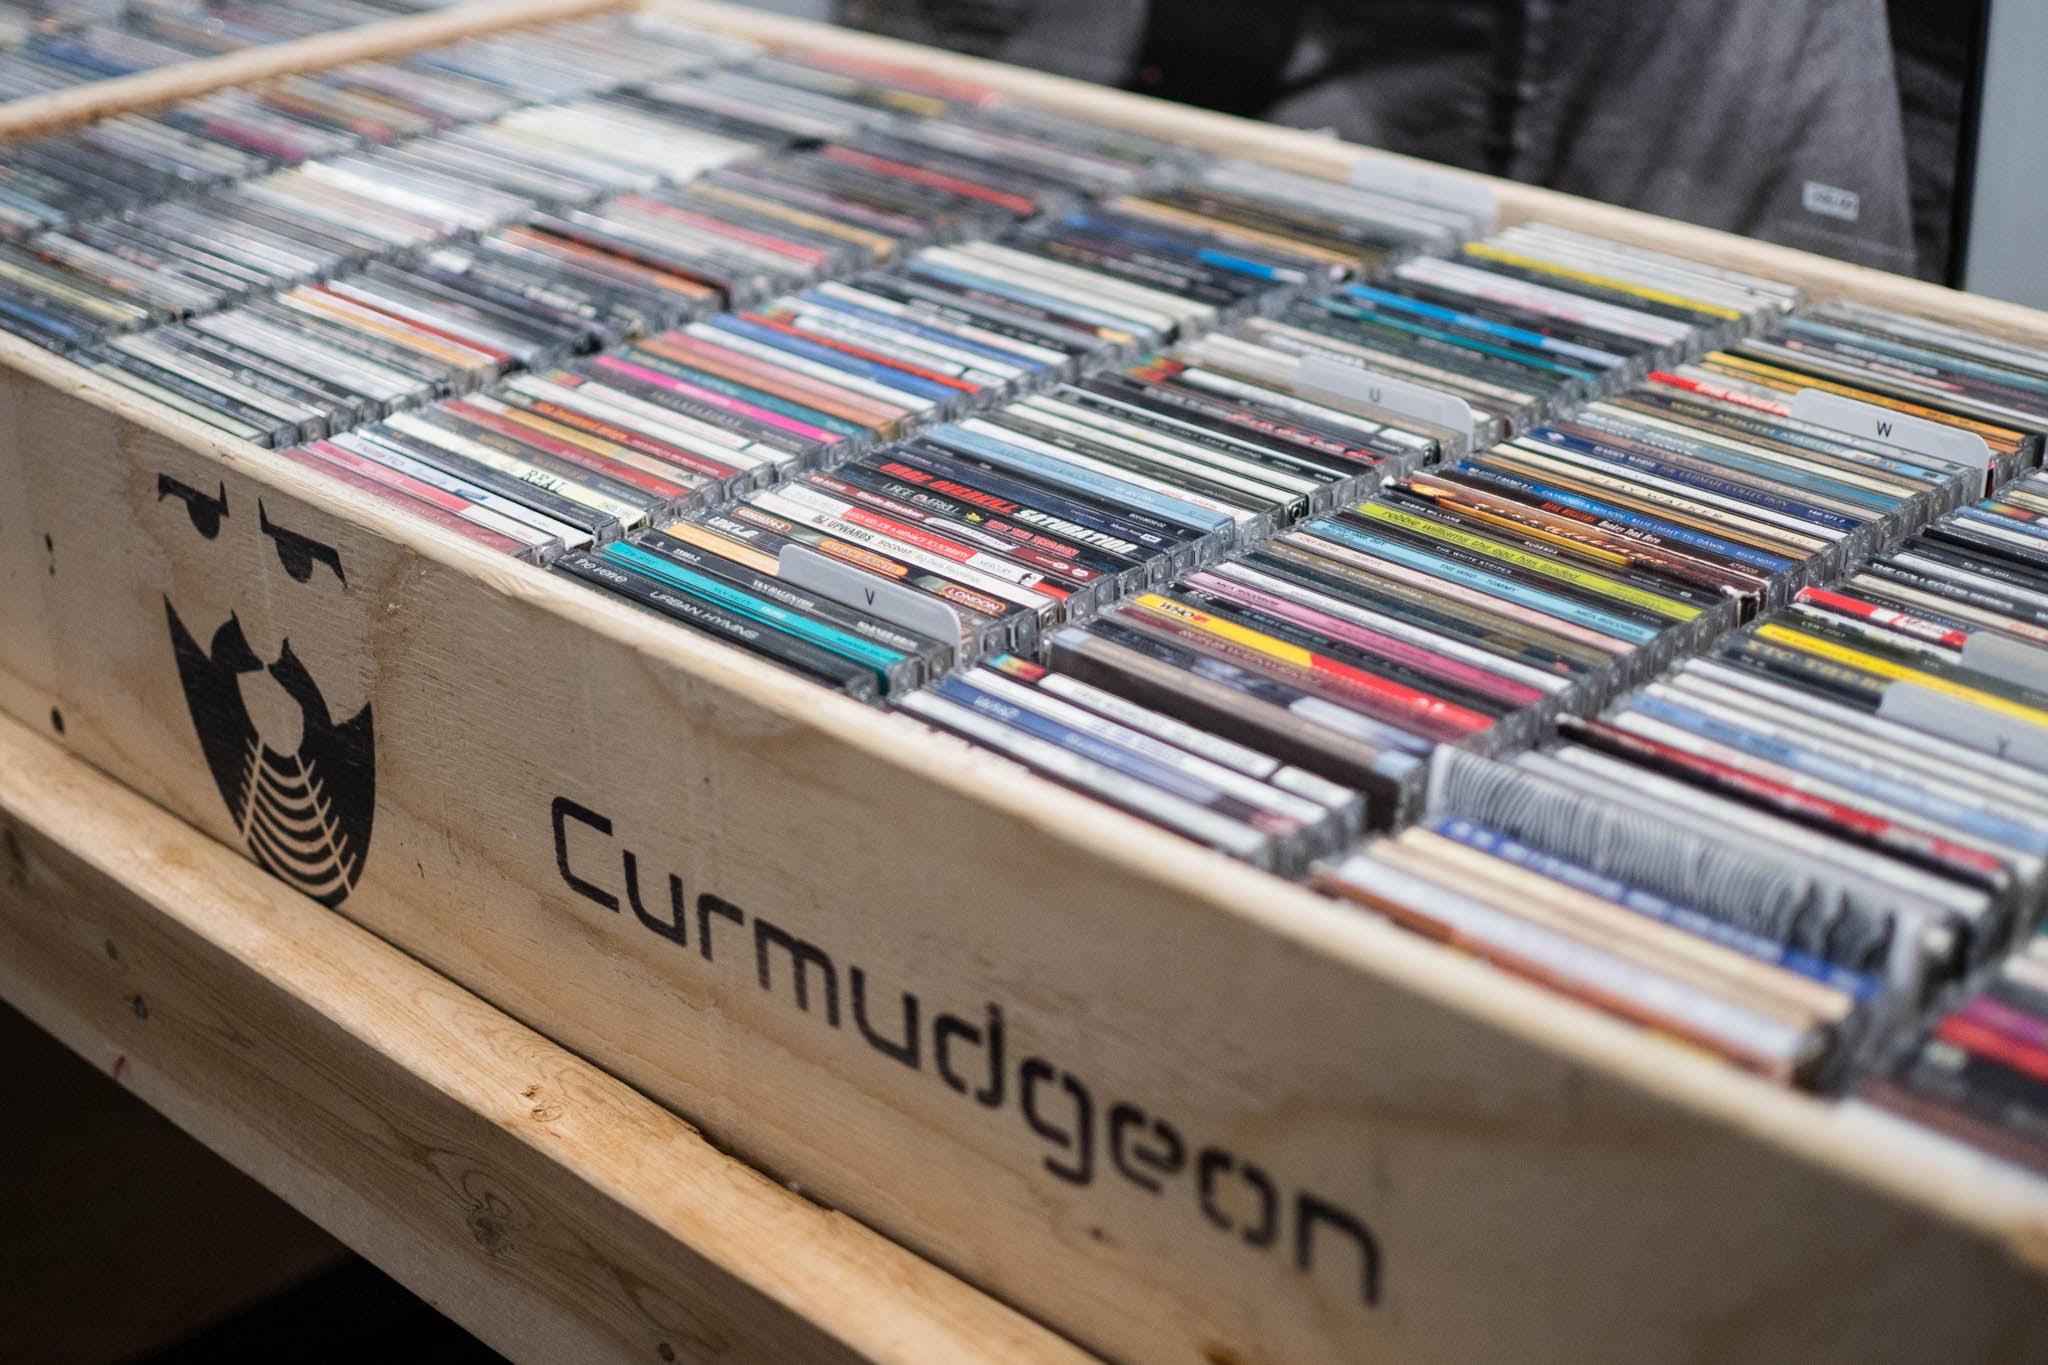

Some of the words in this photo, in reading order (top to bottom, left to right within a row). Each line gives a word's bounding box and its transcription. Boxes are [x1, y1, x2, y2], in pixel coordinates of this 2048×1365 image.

[1369, 387, 1381, 403] U
[1876, 419, 1892, 438] W
[518, 470, 568, 493] REAL
[880, 462, 934, 483] URGE
[928, 480, 1019, 514] OVERKILL
[1013, 508, 1138, 554] SATURATION
[828, 518, 875, 541] UPWARDS
[1382, 511, 1419, 527] robbie
[1421, 521, 1472, 544] williams
[1471, 539, 1492, 550] the
[1524, 540, 1559, 555] RUDEBOX
[1453, 551, 1477, 562] WHITE
[1480, 560, 1513, 575] STRIPES
[826, 542, 857, 559] UTAH
[858, 551, 899, 572] SAINTS
[949, 588, 999, 610] LONDON
[575, 558, 595, 570] the
[650, 590, 703, 616] URBAN
[701, 612, 760, 640] HYMNS
[864, 587, 875, 606] V
[551, 796, 1382, 1309] Curmudgeon
